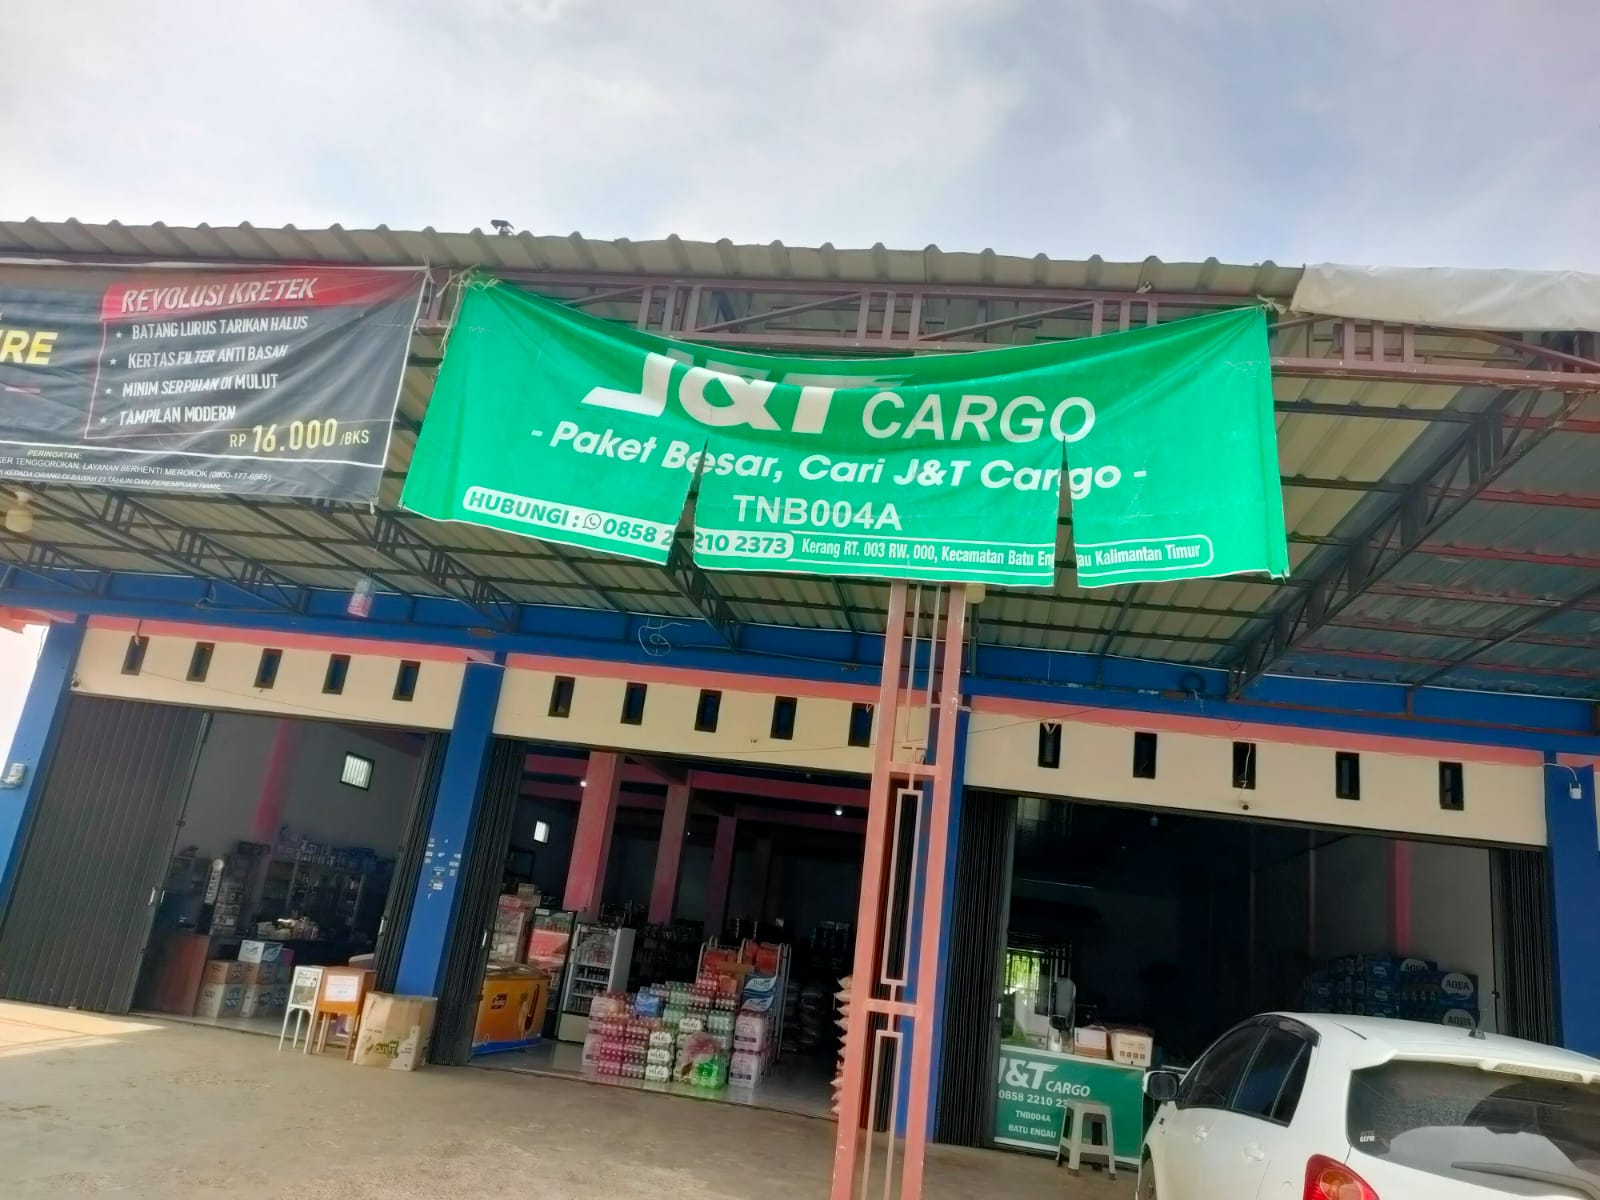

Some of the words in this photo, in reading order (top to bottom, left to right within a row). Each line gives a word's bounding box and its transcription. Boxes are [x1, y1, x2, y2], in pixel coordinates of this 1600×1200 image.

[120, 284, 225, 313] REVOLUSI
[228, 277, 319, 304] KRETEK
[132, 322, 178, 339] BATANG
[180, 320, 216, 337] LURUS
[220, 317, 268, 334] TARIKAN
[270, 315, 309, 331] HALUS
[0, 329, 58, 365] RE
[128, 351, 176, 368] KERTAS
[177, 349, 214, 365] FILTER
[216, 347, 246, 363] ANTI
[248, 345, 288, 360] BASAH
[122, 380, 158, 397] MINIM
[161, 378, 219, 394] SERPIHAN
[220, 376, 234, 391] DI
[234, 374, 279, 391] MULUT
[581, 350, 902, 434] J&T
[862, 391, 1096, 443] CARGO
[119, 406, 181, 425] TAMPILAN
[184, 405, 236, 422] MODERN
[229, 432, 247, 448] RP
[252, 418, 338, 453] 16.000
[340, 430, 369, 446] /BKS
[27, 449, 82, 459] PERINGATAN:
[549, 420, 656, 464] Paket
[661, 439, 783, 483] Besar,
[798, 453, 882, 484] Cari
[893, 459, 971, 487] J&T
[980, 459, 1121, 500] Cargo
[82, 462, 118, 472] LAYANAN
[120, 465, 163, 475] BERHENTI
[164, 468, 208, 478] MEROKOK
[733, 494, 902, 532] TNB004A
[602, 518, 657, 543] 0858
[734, 535, 787, 555] 2373
[802, 537, 841, 558] Kerang
[844, 540, 860, 556] RT.
[863, 542, 885, 557] 003
[888, 543, 910, 559] RW.
[913, 544, 938, 563] 000,
[941, 546, 1004, 564] Kecamatan
[1008, 549, 1034, 566] Batu
[1095, 546, 1163, 566] Kalimantan
[1165, 543, 1201, 560] Timur
[999, 1089, 1025, 1102] 0858
[1027, 1094, 1053, 1106] 2210
[1045, 1080, 1091, 1097] CARGO
[1015, 1110, 1052, 1122] TNB004A
[1008, 1124, 1029, 1134] BATU
[1030, 1127, 1057, 1139] ENGAU
